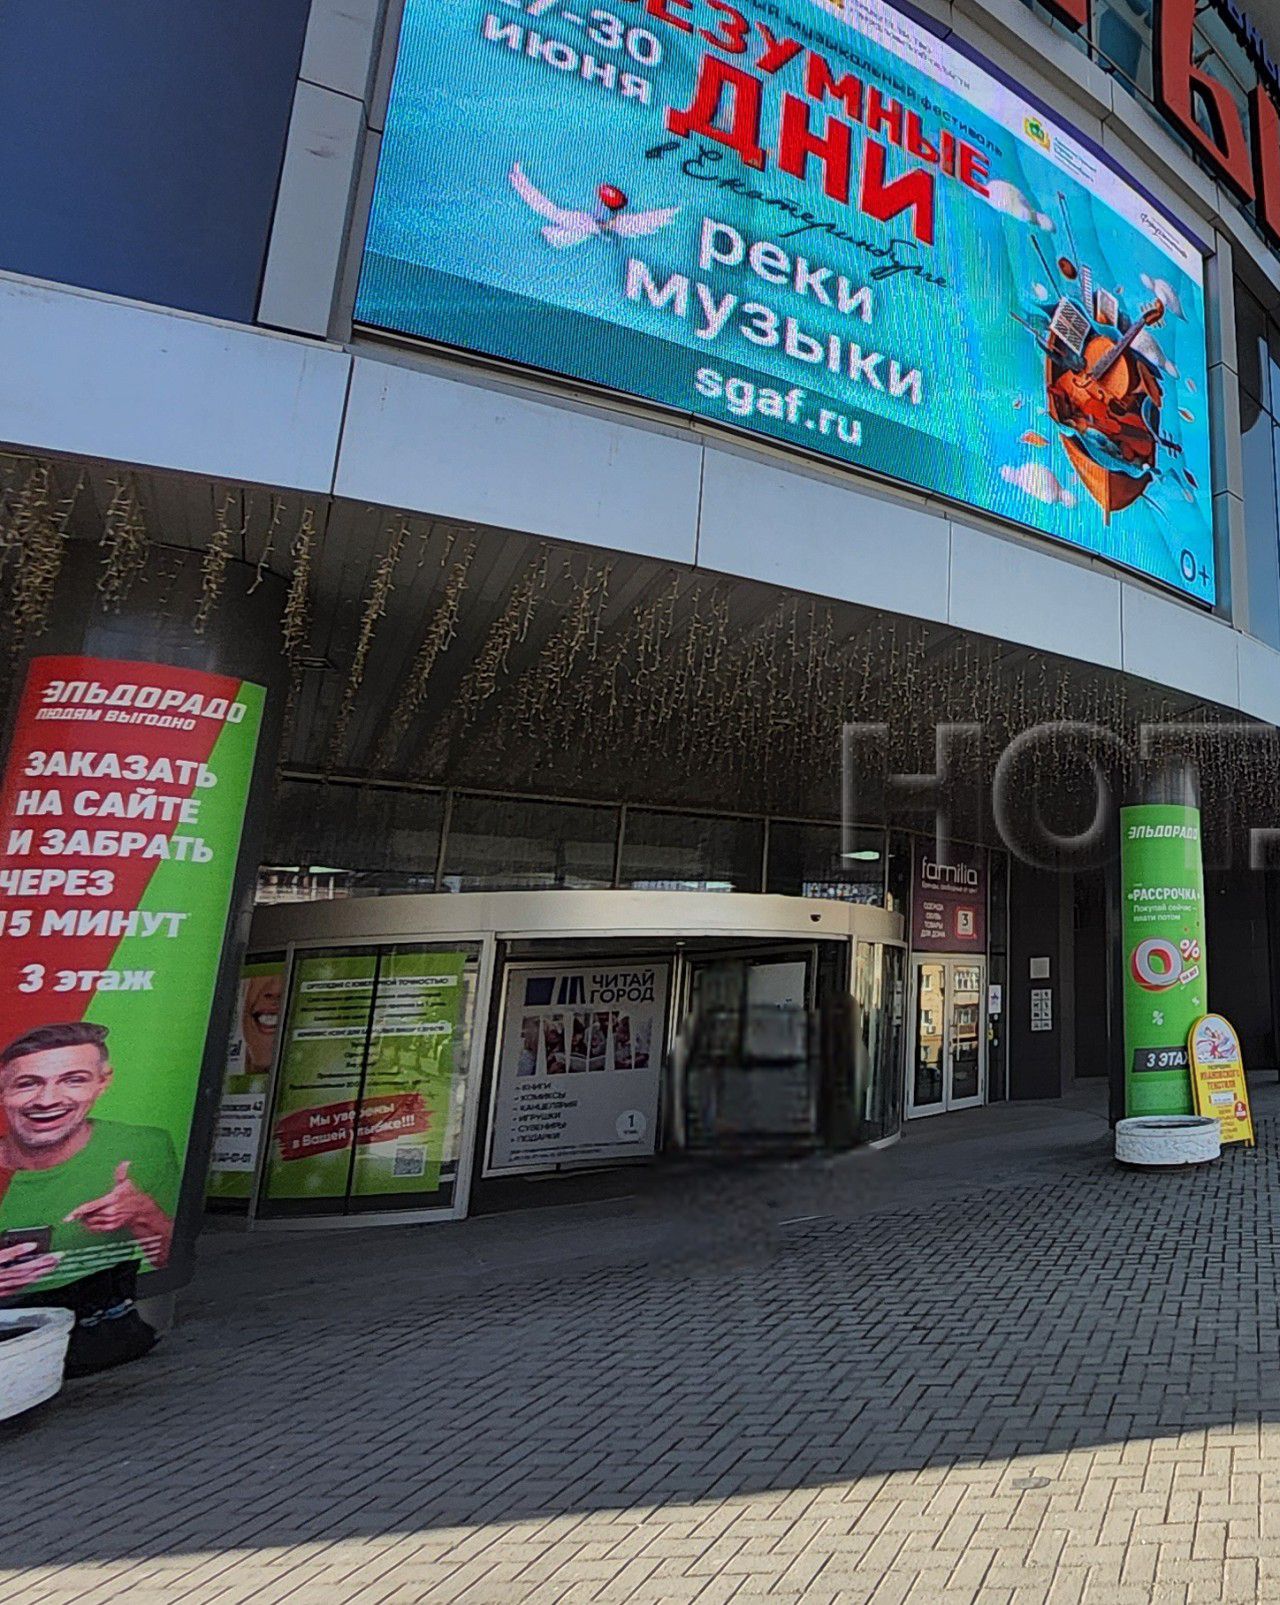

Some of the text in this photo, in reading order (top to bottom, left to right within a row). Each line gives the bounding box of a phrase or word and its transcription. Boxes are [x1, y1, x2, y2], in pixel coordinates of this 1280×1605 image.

[497, 0, 662, 67] -30
[622, 0, 991, 198] ЕЗУМНЫЕ
[667, 53, 934, 247] ДНИ
[700, 217, 873, 324] реки
[626, 258, 922, 405] музыки
[694, 367, 862, 446] sgaf.ru
[1180, 548, 1211, 587] 0+
[40, 680, 248, 724] ЭЛЬДОРАДО
[34, 707, 197, 731] ЛЮДЯМ ВЫГОДНО
[24, 751, 219, 788] ЗАКАЗАТЬ
[14, 787, 202, 825] НА САЙТЕ
[6, 829, 215, 863] И ЗАБРАТЬ
[1128, 825, 1198, 840] ЭЛЬДОРАДО
[0, 869, 115, 896] ЧЕРЕЗ
[922, 855, 978, 885] familia
[40, 909, 188, 938] МИНУТ
[962, 913, 969, 926] 3
[18, 963, 156, 993] 3 этаж
[592, 969, 655, 988] ЧИТАЙ
[590, 987, 655, 1004] ГОРОД
[1147, 1051, 1188, 1067] 3 ЭТА
[309, 1114, 331, 1128] Мы
[628, 1114, 634, 1128] 1
[302, 1128, 347, 1147] Вашей
